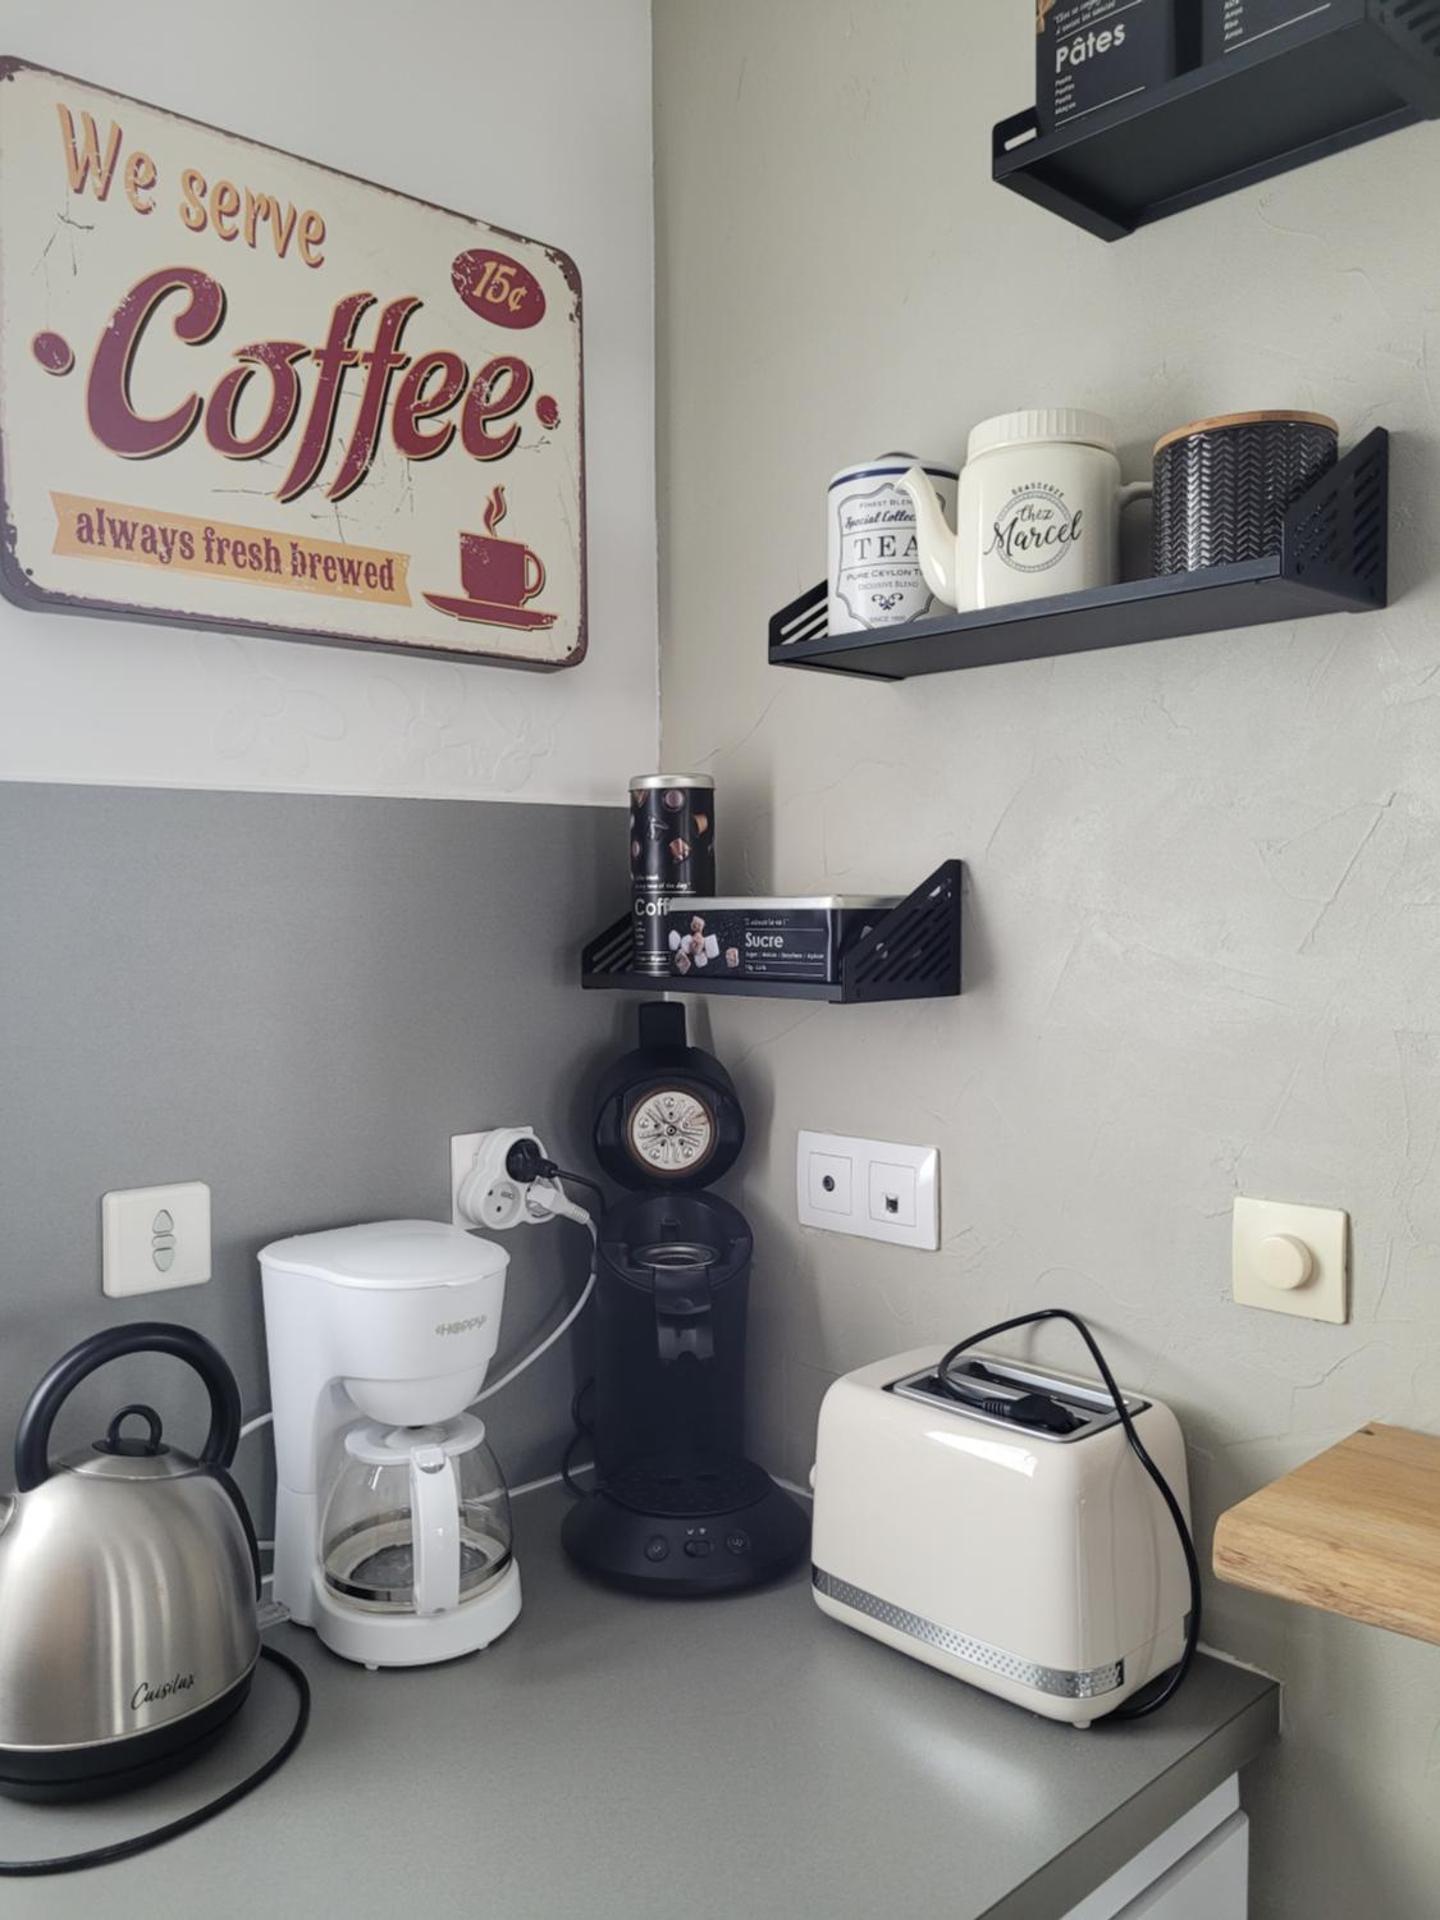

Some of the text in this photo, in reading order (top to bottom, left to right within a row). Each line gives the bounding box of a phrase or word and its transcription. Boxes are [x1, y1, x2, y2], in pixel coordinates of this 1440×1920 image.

[1056, 24, 1125, 74] Pâtes
[56, 102, 327, 269] We serve
[472, 261, 528, 312] 15¢
[86, 266, 533, 503] Coffee
[882, 510, 917, 522] Collec
[889, 498, 913, 506] BLEN
[1015, 503, 1053, 522] Chez
[75, 507, 396, 592] always fresh brewed
[853, 534, 919, 560] TEA
[982, 509, 1083, 557] Marcel
[635, 897, 671, 916] Coff
[745, 932, 784, 948] Sucre
